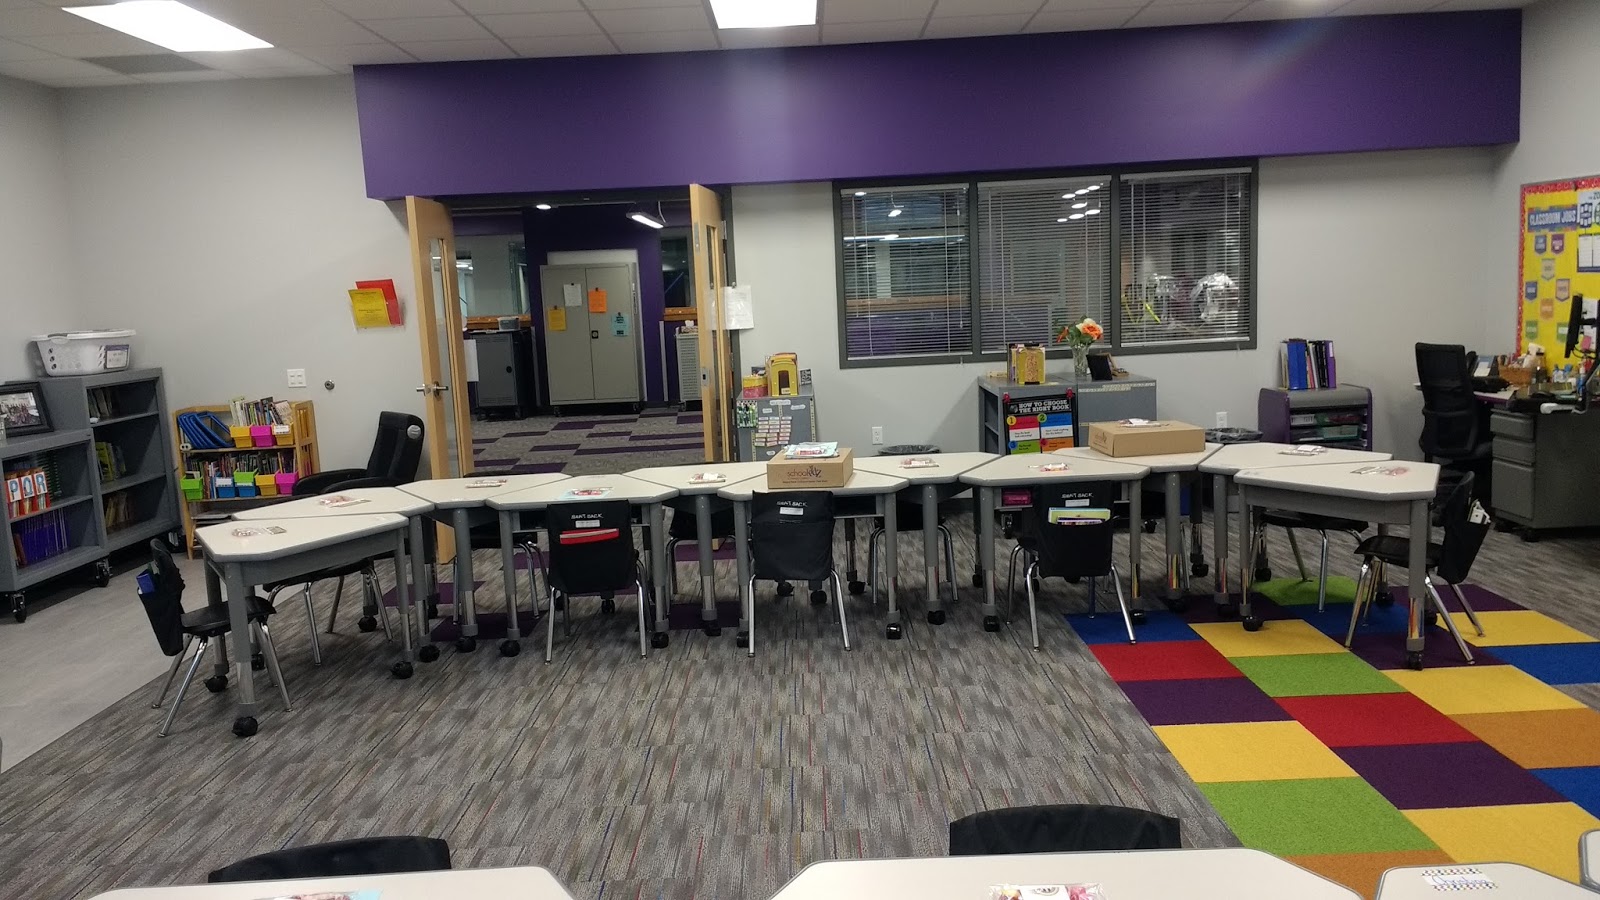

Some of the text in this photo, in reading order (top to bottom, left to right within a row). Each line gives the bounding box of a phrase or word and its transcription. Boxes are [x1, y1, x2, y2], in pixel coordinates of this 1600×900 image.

[1530, 210, 1576, 226] CLASSROOM JOBS
[10, 480, 19, 500] P
[35, 473, 46, 493] R
